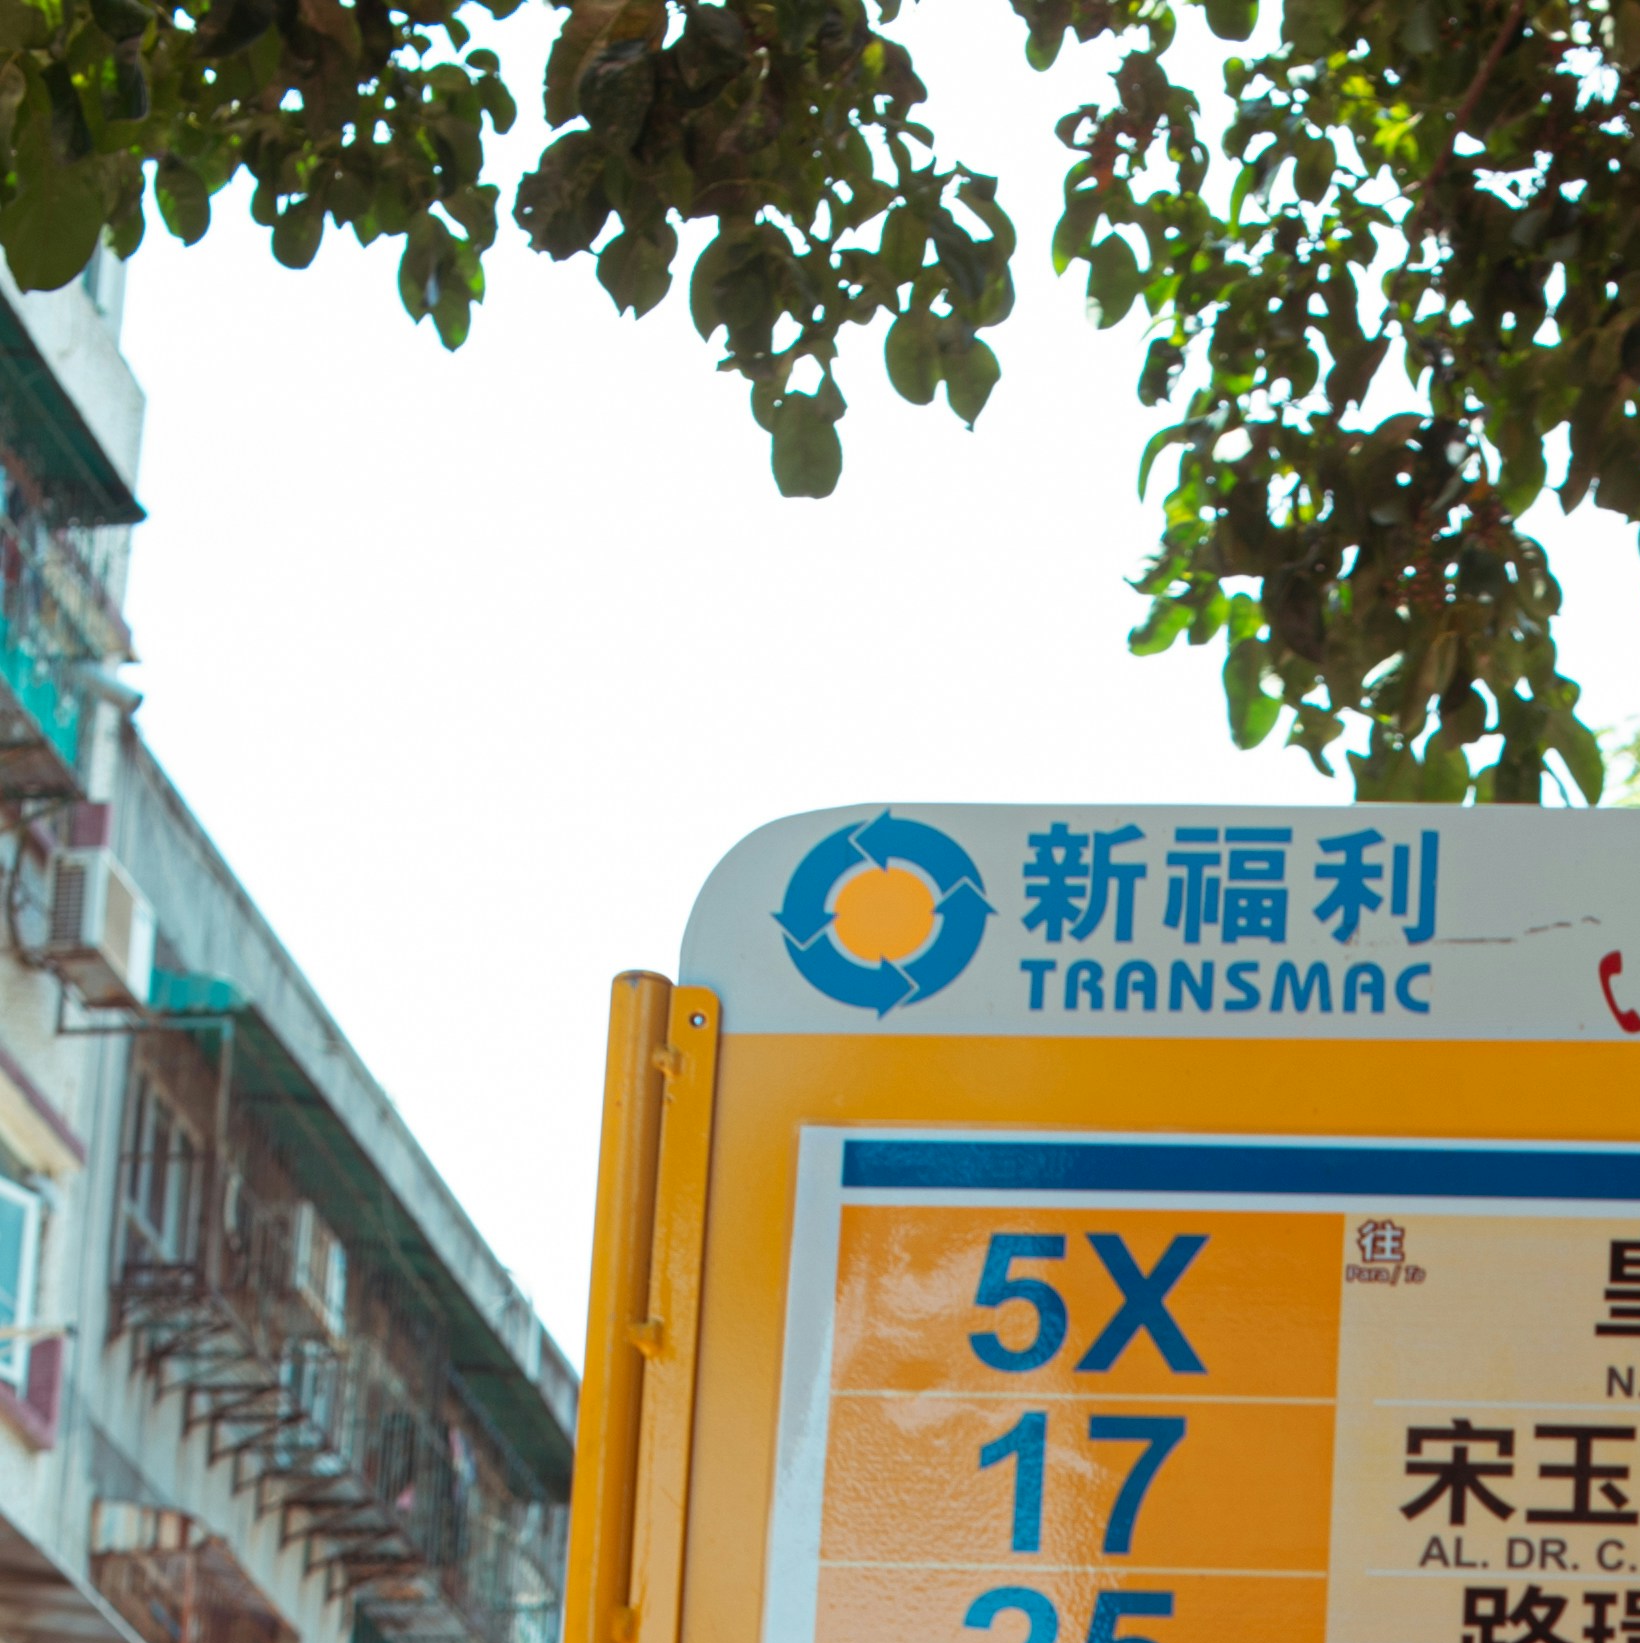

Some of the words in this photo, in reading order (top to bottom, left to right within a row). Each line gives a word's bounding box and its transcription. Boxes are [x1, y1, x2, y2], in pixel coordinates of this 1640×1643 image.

[1022, 822, 1439, 945] 新福利
[1020, 959, 1431, 1014] TRANSMAC
[1356, 1219, 1405, 1263] 往
[967, 1231, 1211, 1374] 5X
[978, 1410, 1187, 1555] 17
[1419, 1536, 1488, 1568] AL.
[1507, 1538, 1579, 1570] DR.
[1596, 1539, 1638, 1573] C.
